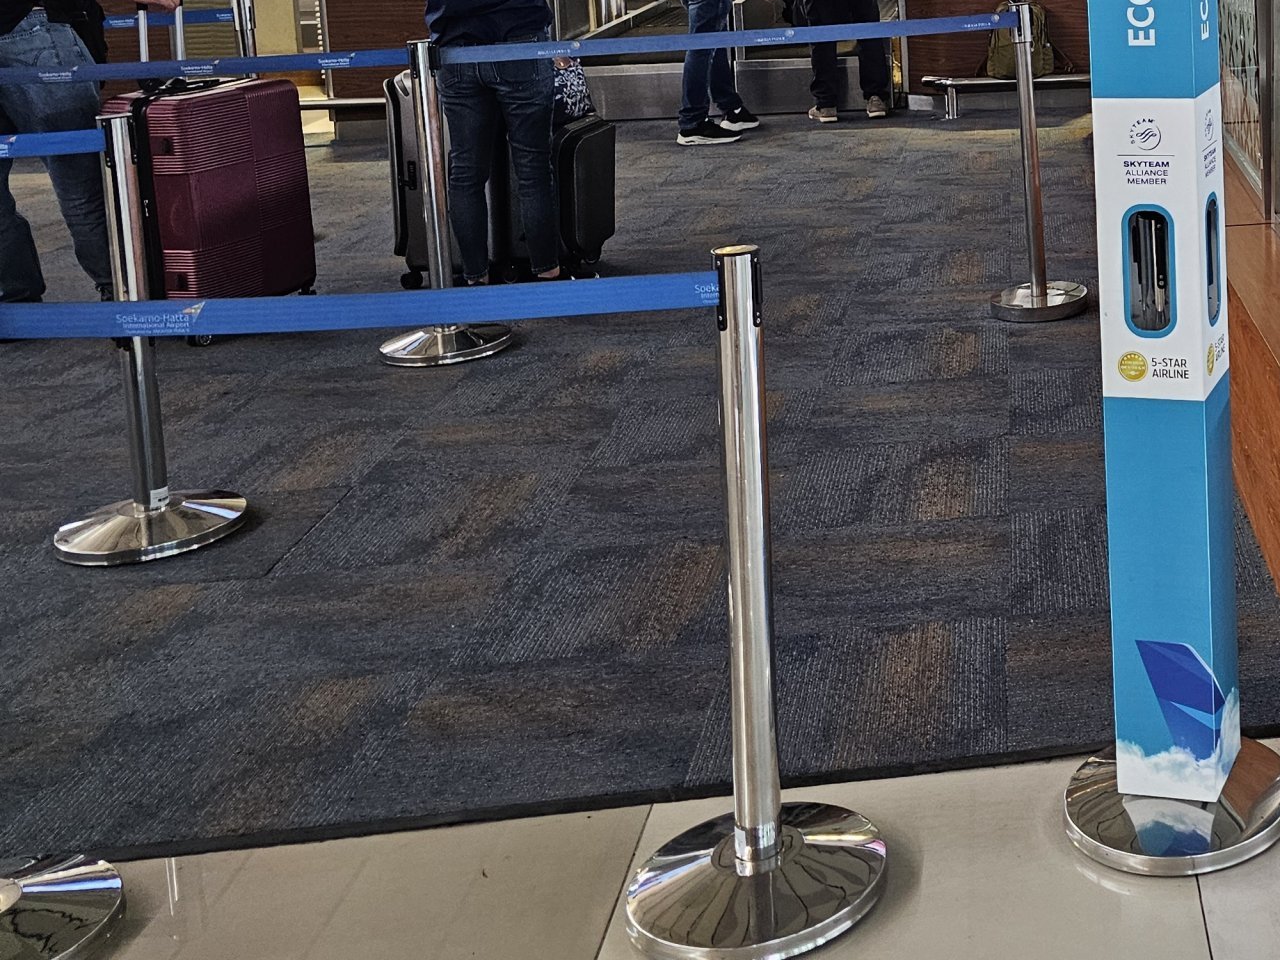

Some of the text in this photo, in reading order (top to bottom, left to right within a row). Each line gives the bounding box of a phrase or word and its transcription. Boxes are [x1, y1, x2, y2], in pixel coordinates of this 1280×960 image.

[1123, 160, 1170, 168] SKYTEAM
[1125, 169, 1169, 177] ALLIANCE
[1127, 177, 1167, 185] MEMBER
[115, 313, 190, 324] Soekarno-Hatta
[1151, 357, 1187, 368] 5-STAR
[1152, 368, 1190, 380] AIRLINE
